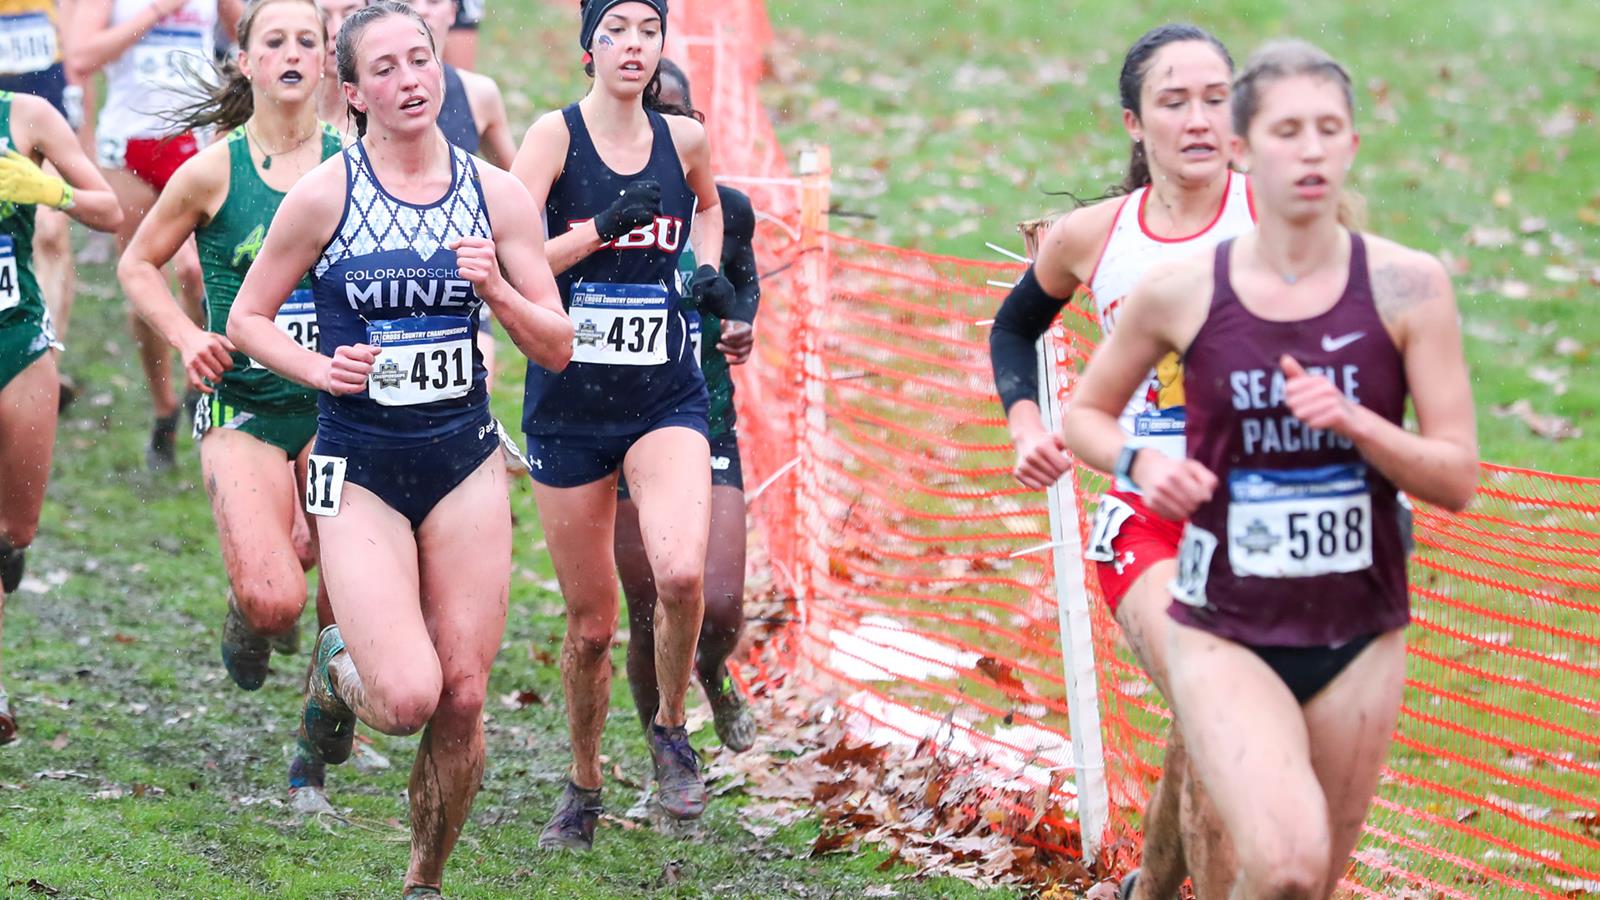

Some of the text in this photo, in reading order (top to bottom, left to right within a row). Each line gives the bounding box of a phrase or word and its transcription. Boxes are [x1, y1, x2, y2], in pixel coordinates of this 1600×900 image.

[567, 215, 684, 254] BU
[345, 279, 484, 310] MINE
[401, 331, 426, 340] COUNTRY
[607, 316, 663, 352] 437
[411, 348, 467, 390] 431
[1230, 364, 1361, 410] SEALE
[308, 458, 335, 508] 31
[1288, 506, 1363, 560] 588
